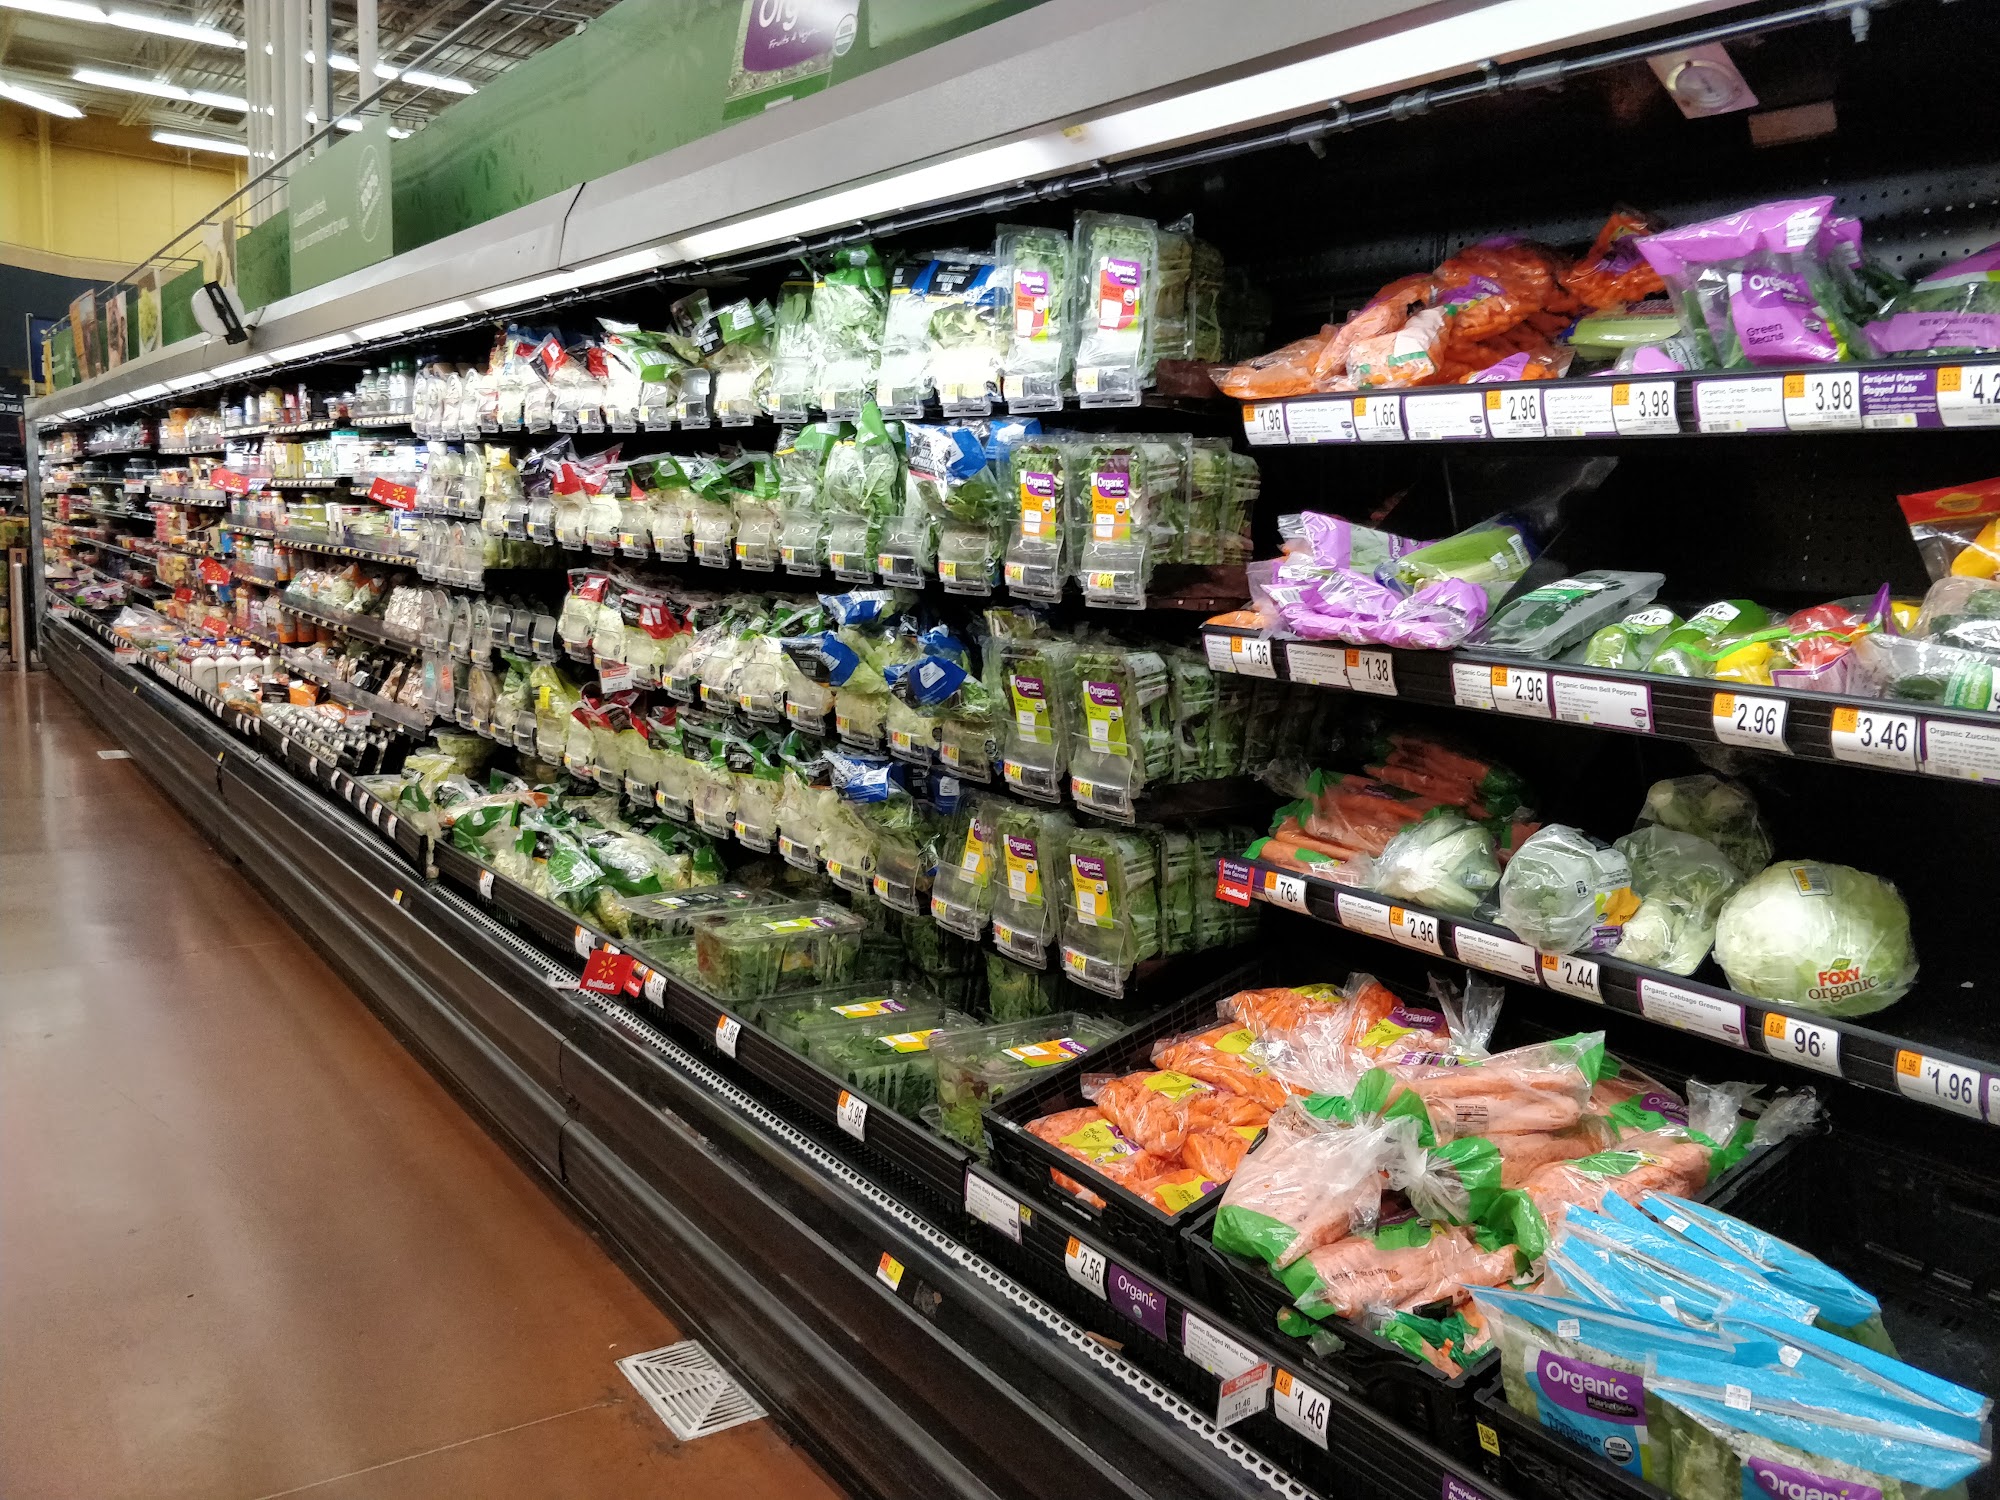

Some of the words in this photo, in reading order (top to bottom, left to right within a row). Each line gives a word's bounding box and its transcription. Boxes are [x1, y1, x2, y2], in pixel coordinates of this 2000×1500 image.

[1107, 261, 1137, 278] Organic
[1746, 322, 1783, 337] Green
[1748, 332, 1785, 346] Beans
[1862, 374, 1896, 385] Certified
[1896, 371, 1927, 384] Organic
[1701, 388, 1726, 397] Organic
[1729, 387, 1748, 395] Green
[1751, 386, 1773, 394] Beans
[1862, 384, 1895, 397] Bagged
[1896, 383, 1918, 394] Kale
[1026, 475, 1051, 489] Organic
[1097, 477, 1125, 490] Organic
[1288, 648, 1307, 656] Organic
[1307, 649, 1319, 657] Green
[1455, 668, 1476, 677] Organic
[1016, 679, 1040, 691] Organic
[1089, 685, 1115, 698] Organic
[1511, 674, 1543, 703] $2.96
[1555, 680, 1579, 691] Organic
[1579, 682, 1598, 692] Green
[1598, 685, 1611, 694] Bell
[1611, 686, 1637, 698] Peppers
[1733, 703, 1777, 736] $2.96
[1857, 717, 1908, 752] $3.46
[1929, 727, 1963, 739] Organic
[1009, 839, 1032, 851] Organic
[1077, 858, 1101, 872] Organic
[1234, 863, 1249, 873] Organic
[1225, 886, 1249, 900] Rollback
[1280, 881, 1298, 903] 76¢
[1340, 897, 1357, 907] Organic
[1358, 902, 1382, 914] Cauliflower
[1407, 916, 1434, 944] $2.96
[1457, 931, 1477, 942] Organic
[1478, 937, 1500, 948] Broccoli
[1562, 960, 1594, 991] $2.44
[1817, 966, 1860, 987] FOXY
[586, 978, 615, 991] Rollback
[1808, 975, 1879, 1003] organic
[1643, 984, 1669, 998] Organic
[1669, 991, 1697, 1006] Cabbage
[1698, 1001, 1722, 1012] Greens
[1392, 1006, 1436, 1023] Organic
[1794, 1027, 1826, 1058] 96¢
[1927, 1066, 1973, 1105] $1.96
[1080, 1249, 1101, 1285] $2.56
[1117, 1275, 1158, 1311] Organic
[1187, 1319, 1206, 1337] Organic
[1206, 1330, 1224, 1347] Bagged
[1224, 1342, 1239, 1357] Whole
[1545, 1361, 1629, 1401] Organic
[1234, 1397, 1251, 1411] $1.46
[1294, 1389, 1325, 1430] $1.46
[1609, 1441, 1627, 1450] USDA
